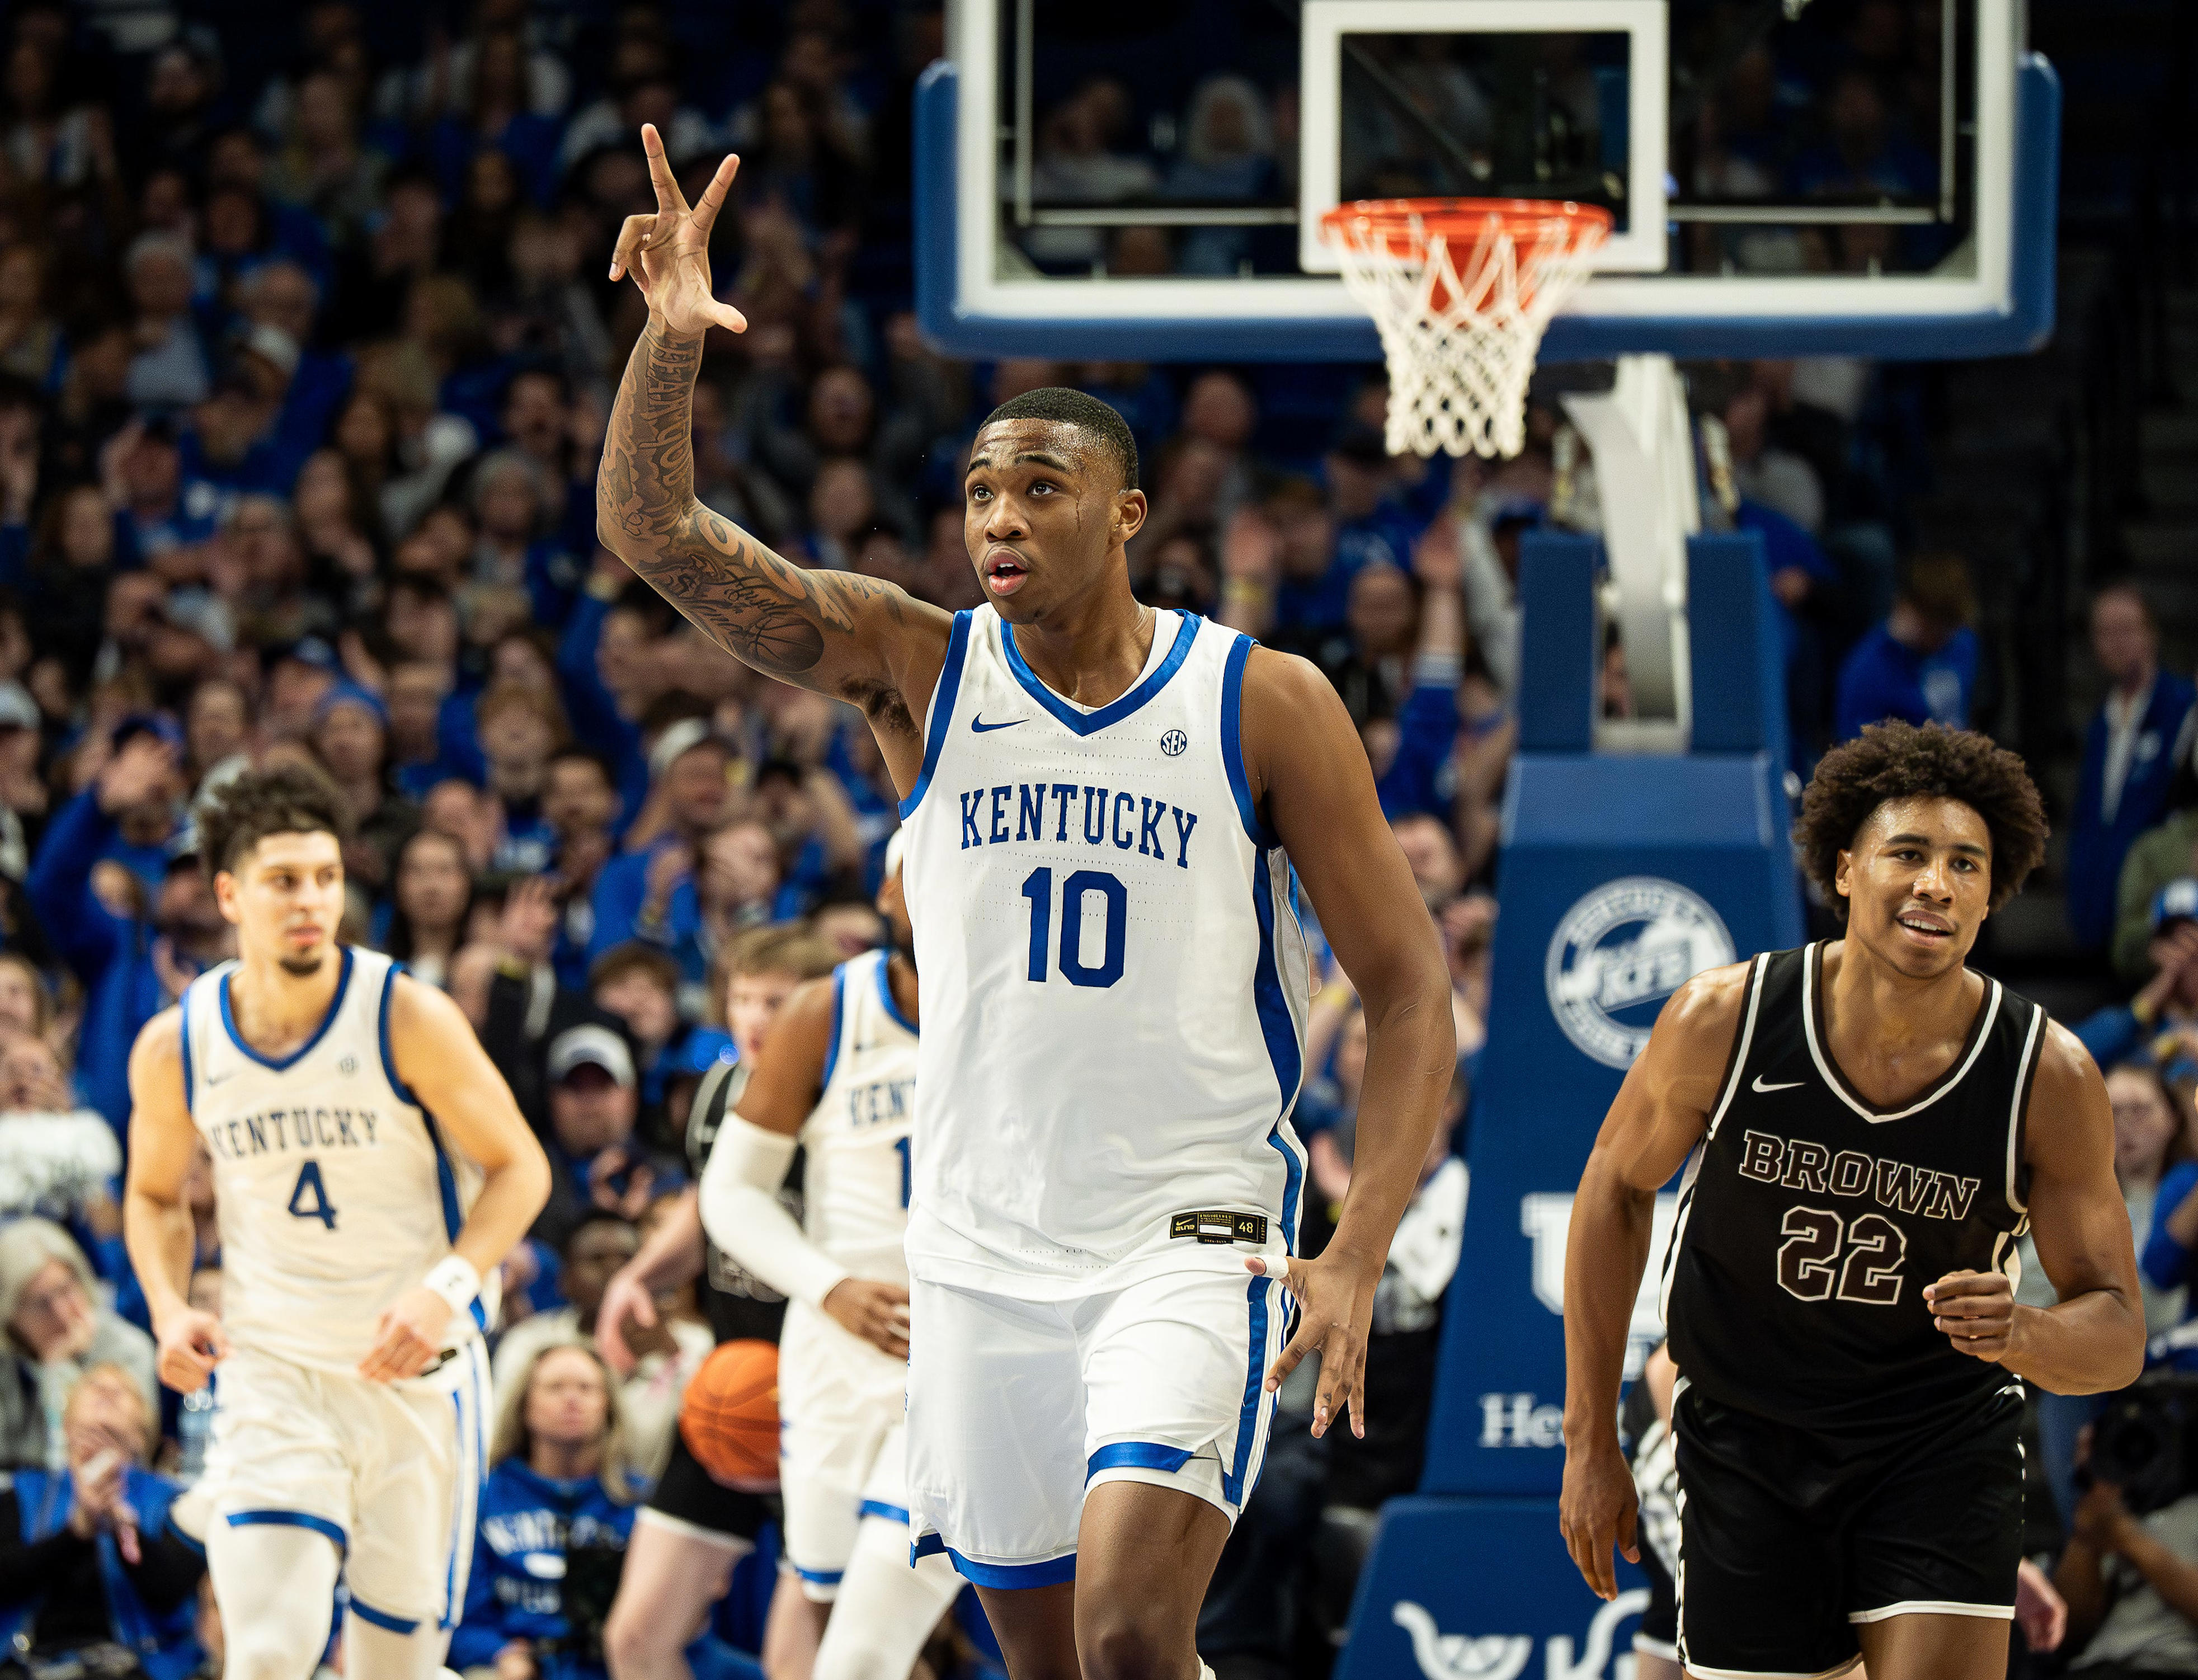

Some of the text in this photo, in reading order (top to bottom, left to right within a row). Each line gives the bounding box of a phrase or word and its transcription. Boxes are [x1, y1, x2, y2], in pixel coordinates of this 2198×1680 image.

[1162, 731, 1186, 755] SEC
[961, 783, 1197, 868] KENTUCKY
[1021, 867, 1128, 988] 10
[211, 1106, 378, 1160] KENTUCKY
[287, 1159, 337, 1231] 4
[1739, 1129, 1981, 1220] BROWN
[1239, 1222, 1253, 1234] 48
[1777, 1205, 1908, 1305] 22
